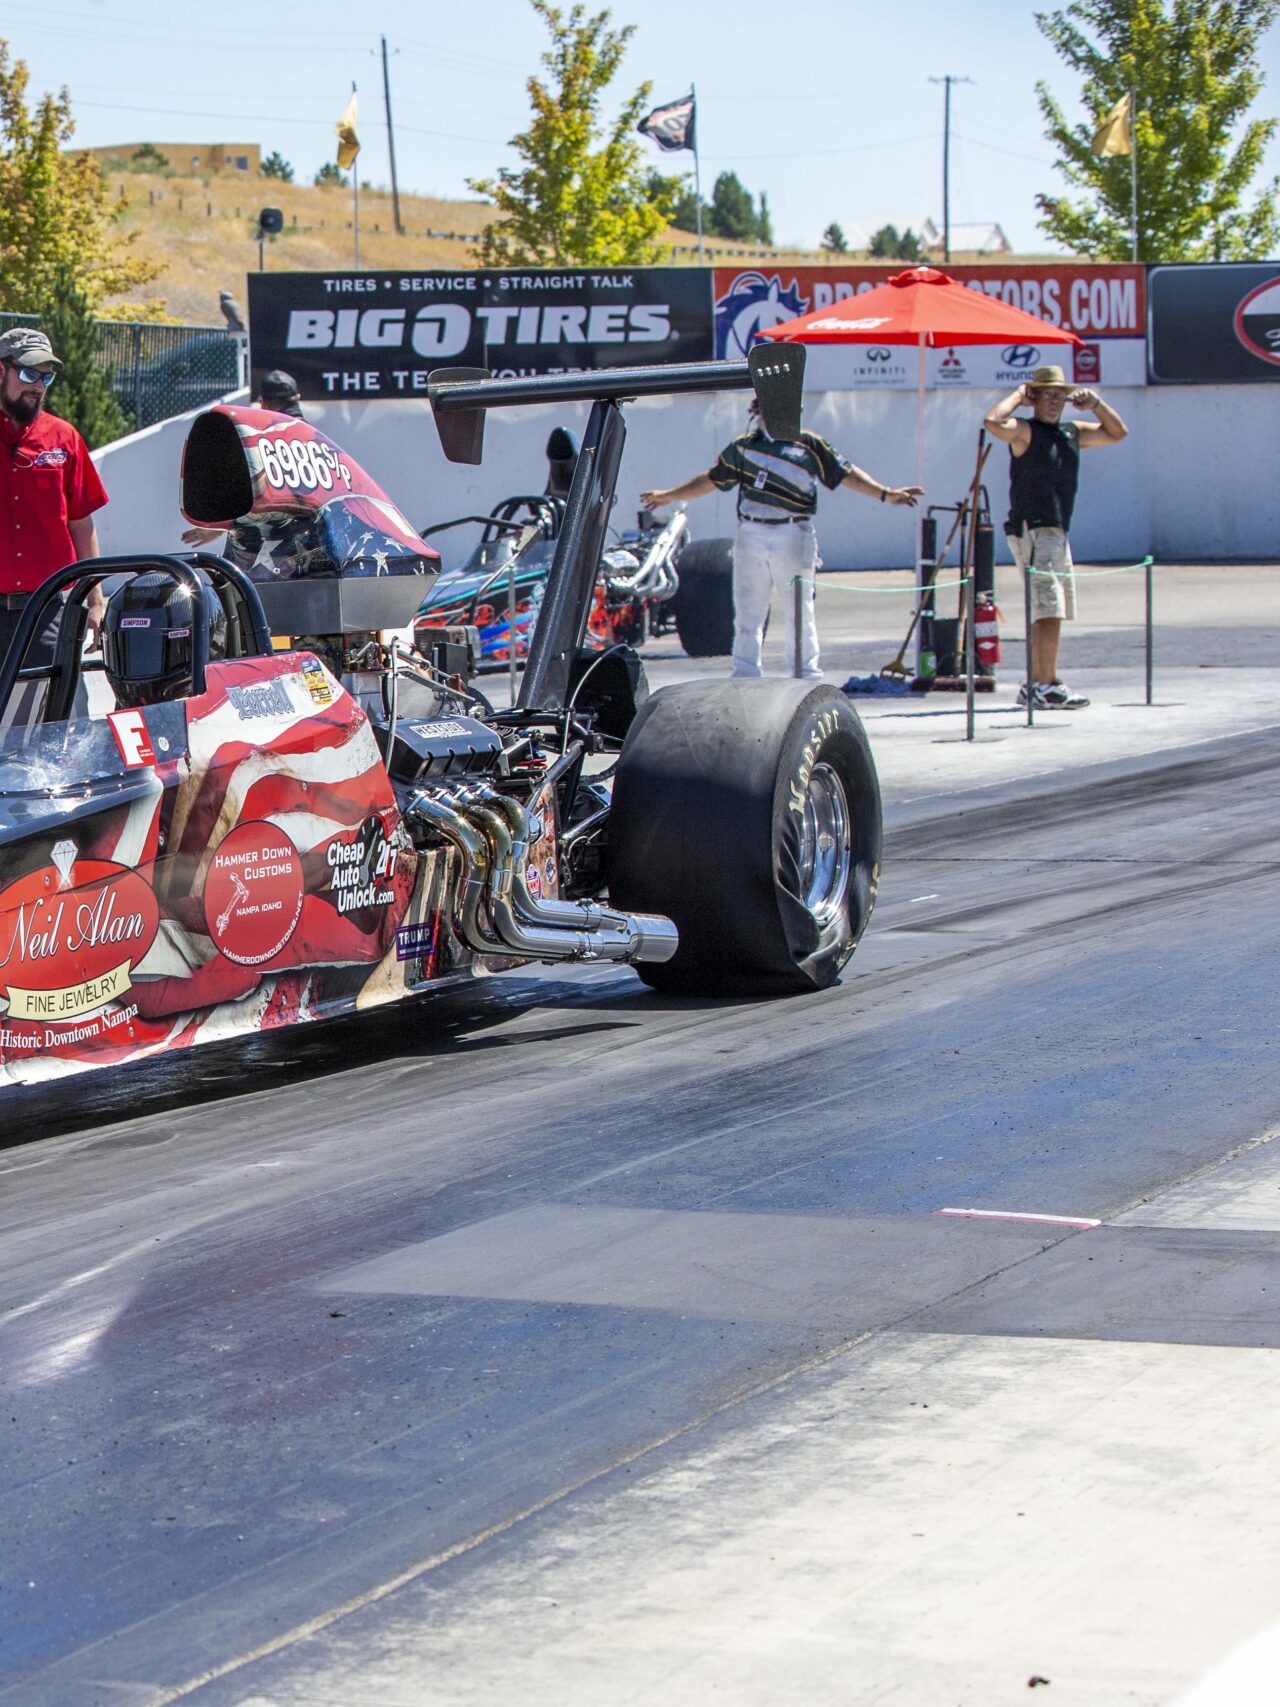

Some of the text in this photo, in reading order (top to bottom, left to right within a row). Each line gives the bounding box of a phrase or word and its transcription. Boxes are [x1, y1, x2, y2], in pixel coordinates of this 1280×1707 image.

[323, 276, 633, 292] TIRES SERVICE STRAIGHT TALK
[286, 303, 671, 358] BIG O TIRES
[322, 372, 380, 391] THE
[258, 437, 333, 490] 6986
[327, 841, 365, 866] Cheap
[331, 865, 360, 890] Auto
[67, 885, 145, 952] Alan
[236, 901, 282, 916] NAMPA IDAHO
[398, 927, 431, 946] TRUMP
[26, 972, 118, 1013] FINE JEWELRY
[0, 1003, 139, 1049] Historic Downtown Nampa
